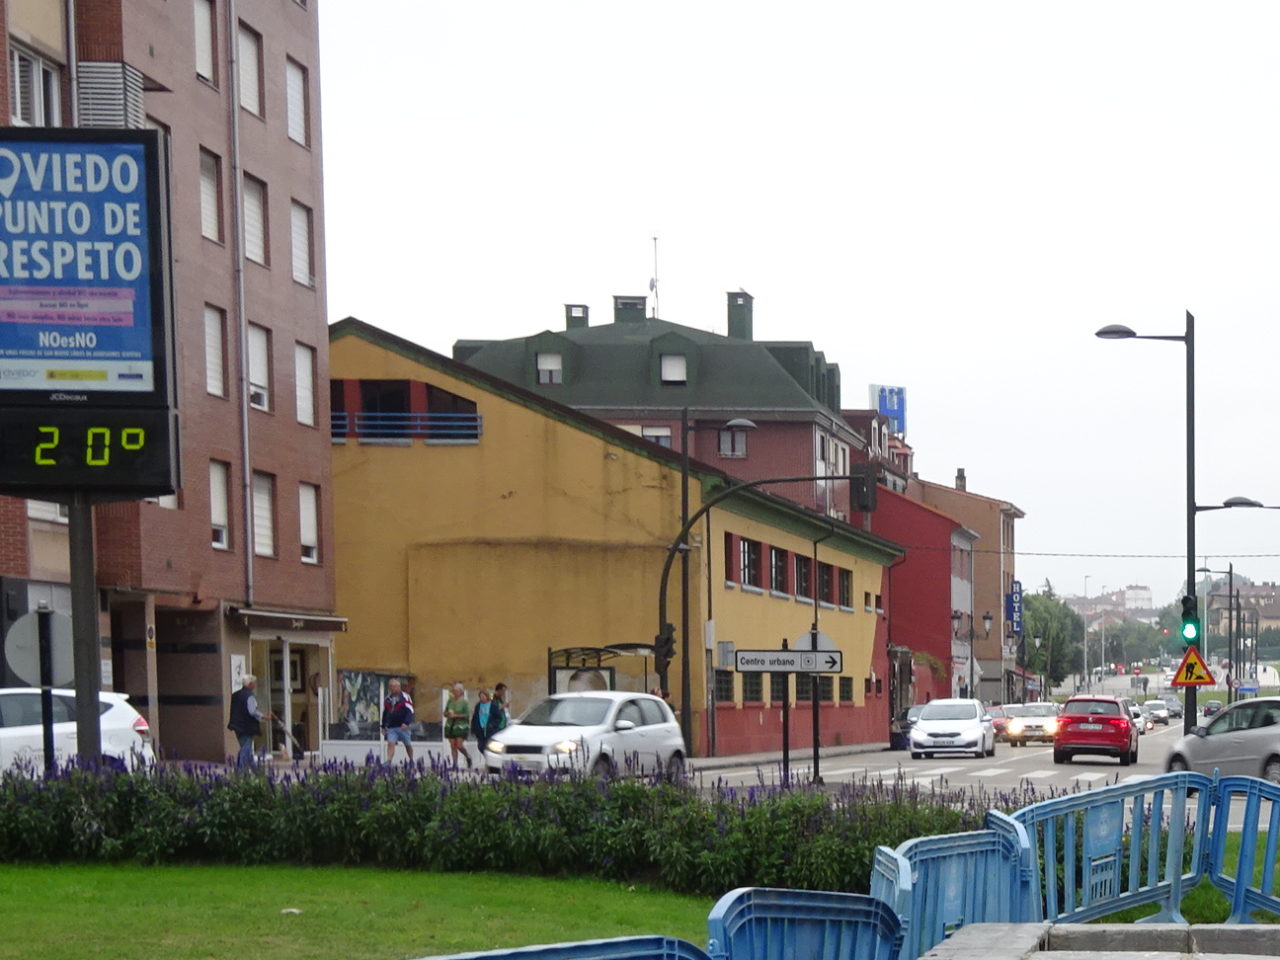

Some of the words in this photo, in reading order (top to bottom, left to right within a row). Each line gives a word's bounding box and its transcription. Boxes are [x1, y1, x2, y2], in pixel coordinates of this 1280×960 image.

[0, 200, 91, 236] UNTO
[104, 202, 140, 236] DE
[39, 332, 97, 349] NOesNO
[1012, 583, 1021, 632] HOTEL
[740, 657, 766, 666] Centro
[769, 657, 795, 666] urbano
